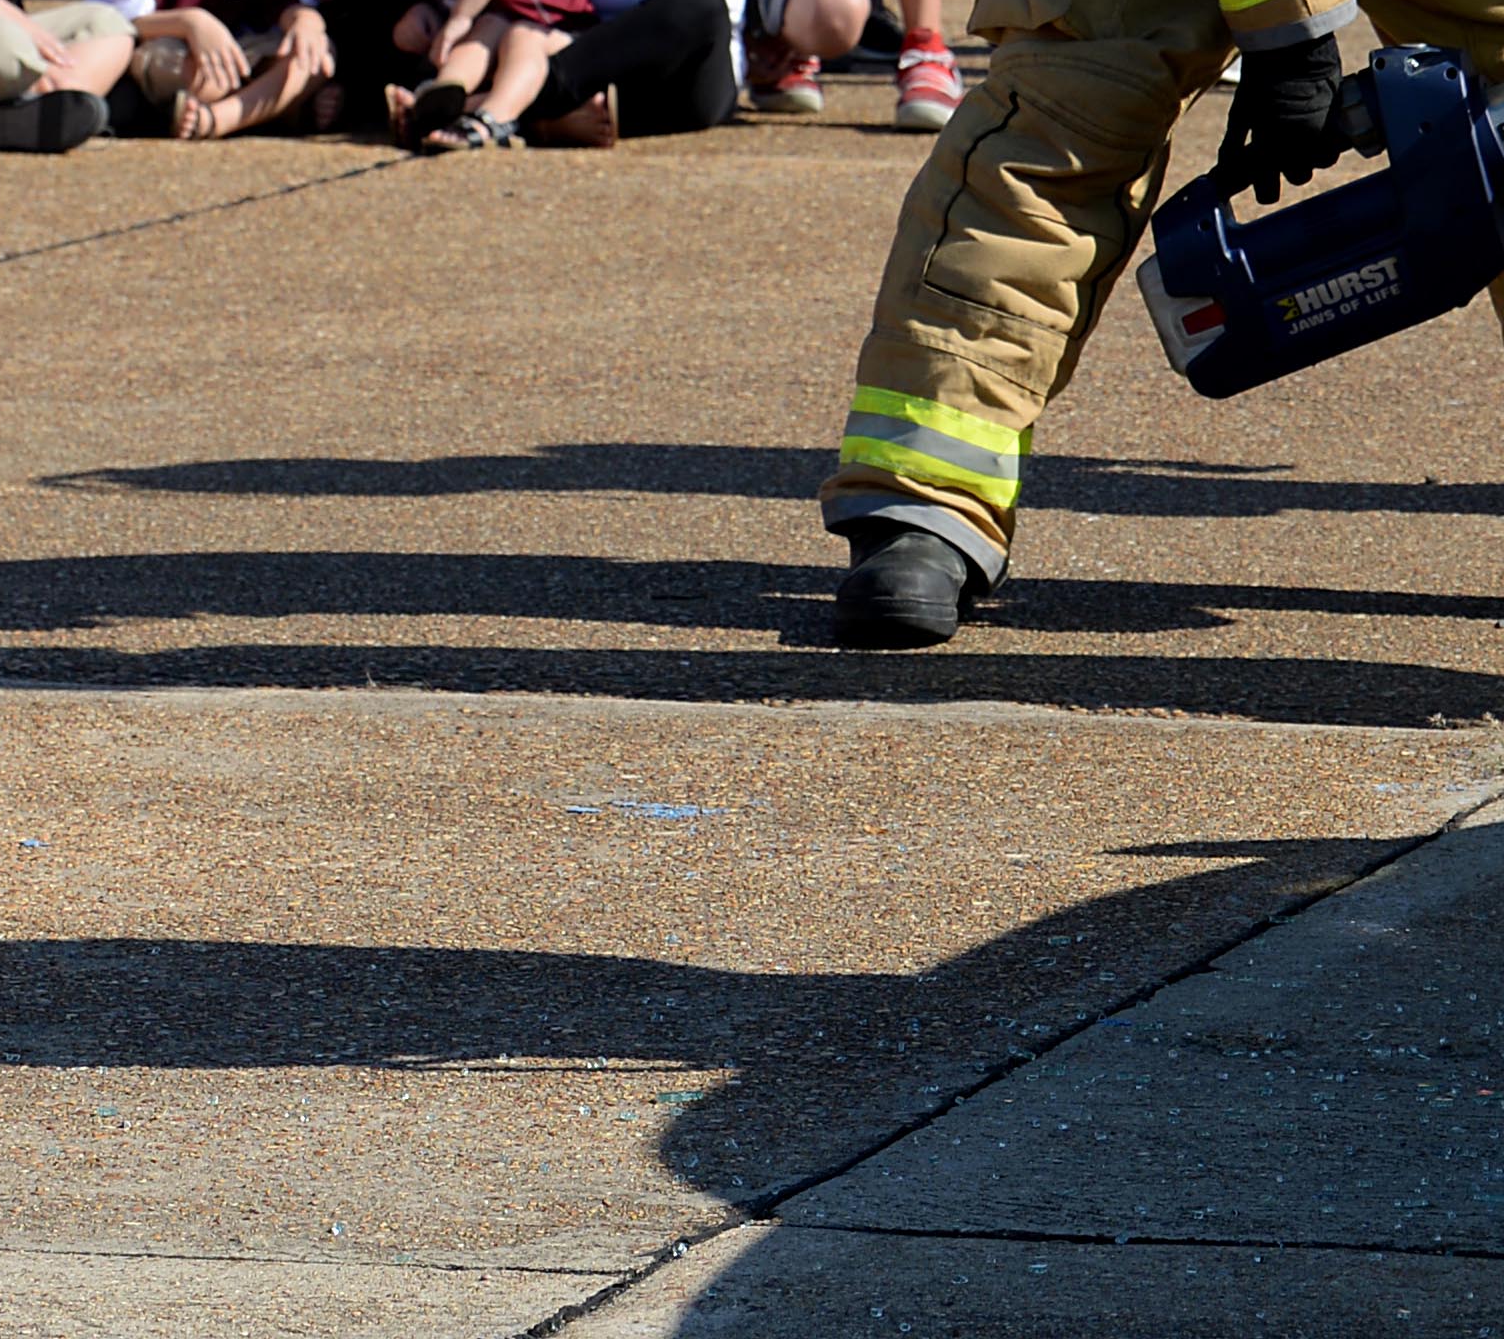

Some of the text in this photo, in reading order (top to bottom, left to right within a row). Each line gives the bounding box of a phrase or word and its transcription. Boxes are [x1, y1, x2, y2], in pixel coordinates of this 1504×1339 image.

[1289, 284, 1402, 335] JAWS OF LIFE
[1295, 257, 1399, 314] HURST
